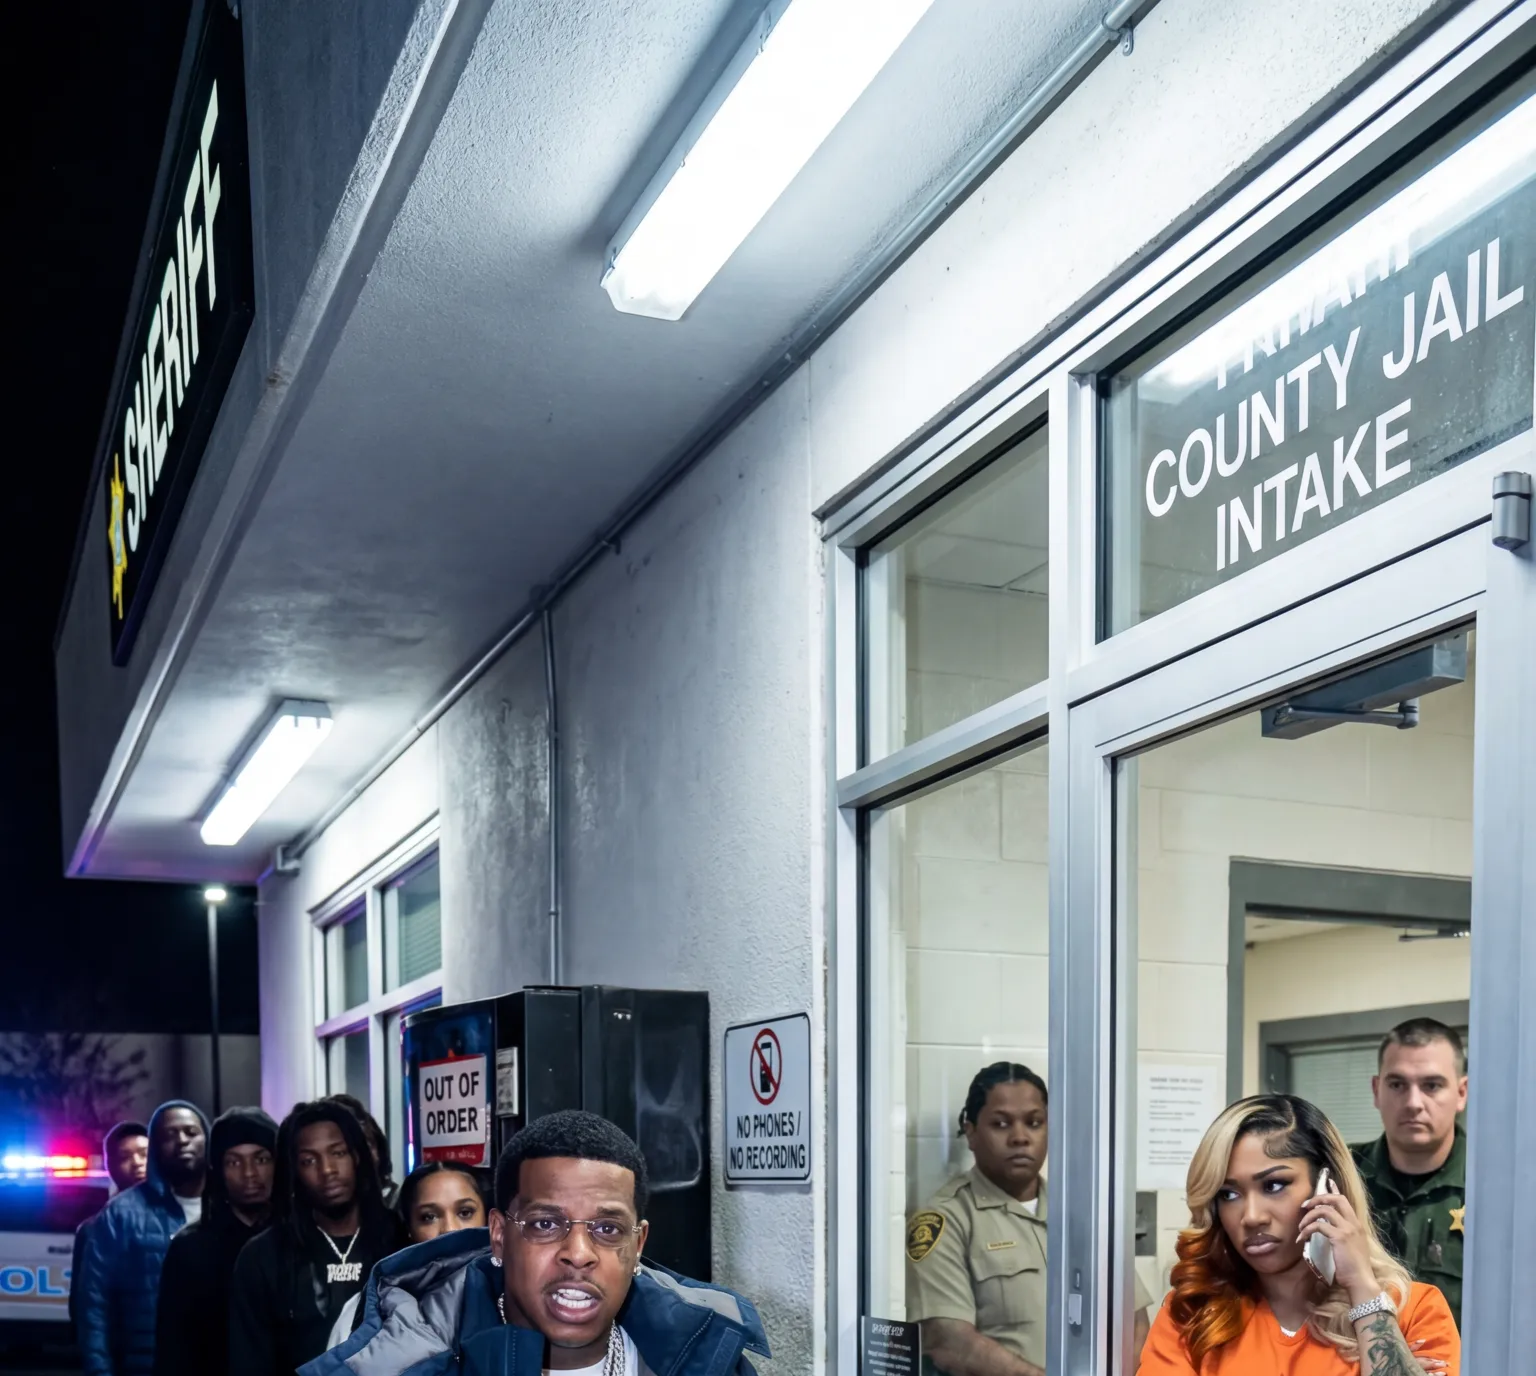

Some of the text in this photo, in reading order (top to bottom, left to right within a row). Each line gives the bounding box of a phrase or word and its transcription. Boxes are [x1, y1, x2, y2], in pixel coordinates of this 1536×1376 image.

[124, 78, 221, 552] SHERIFF
[1145, 326, 1361, 517] COUNTY
[1382, 237, 1524, 379] JAIL
[1215, 398, 1412, 571] INTAKE
[424, 1071, 479, 1102] OUT OF
[426, 1107, 478, 1135] ORDER
[736, 1114, 751, 1138] NO
[753, 1111, 795, 1138] PHONES
[730, 1143, 806, 1170] NO RECORDING
